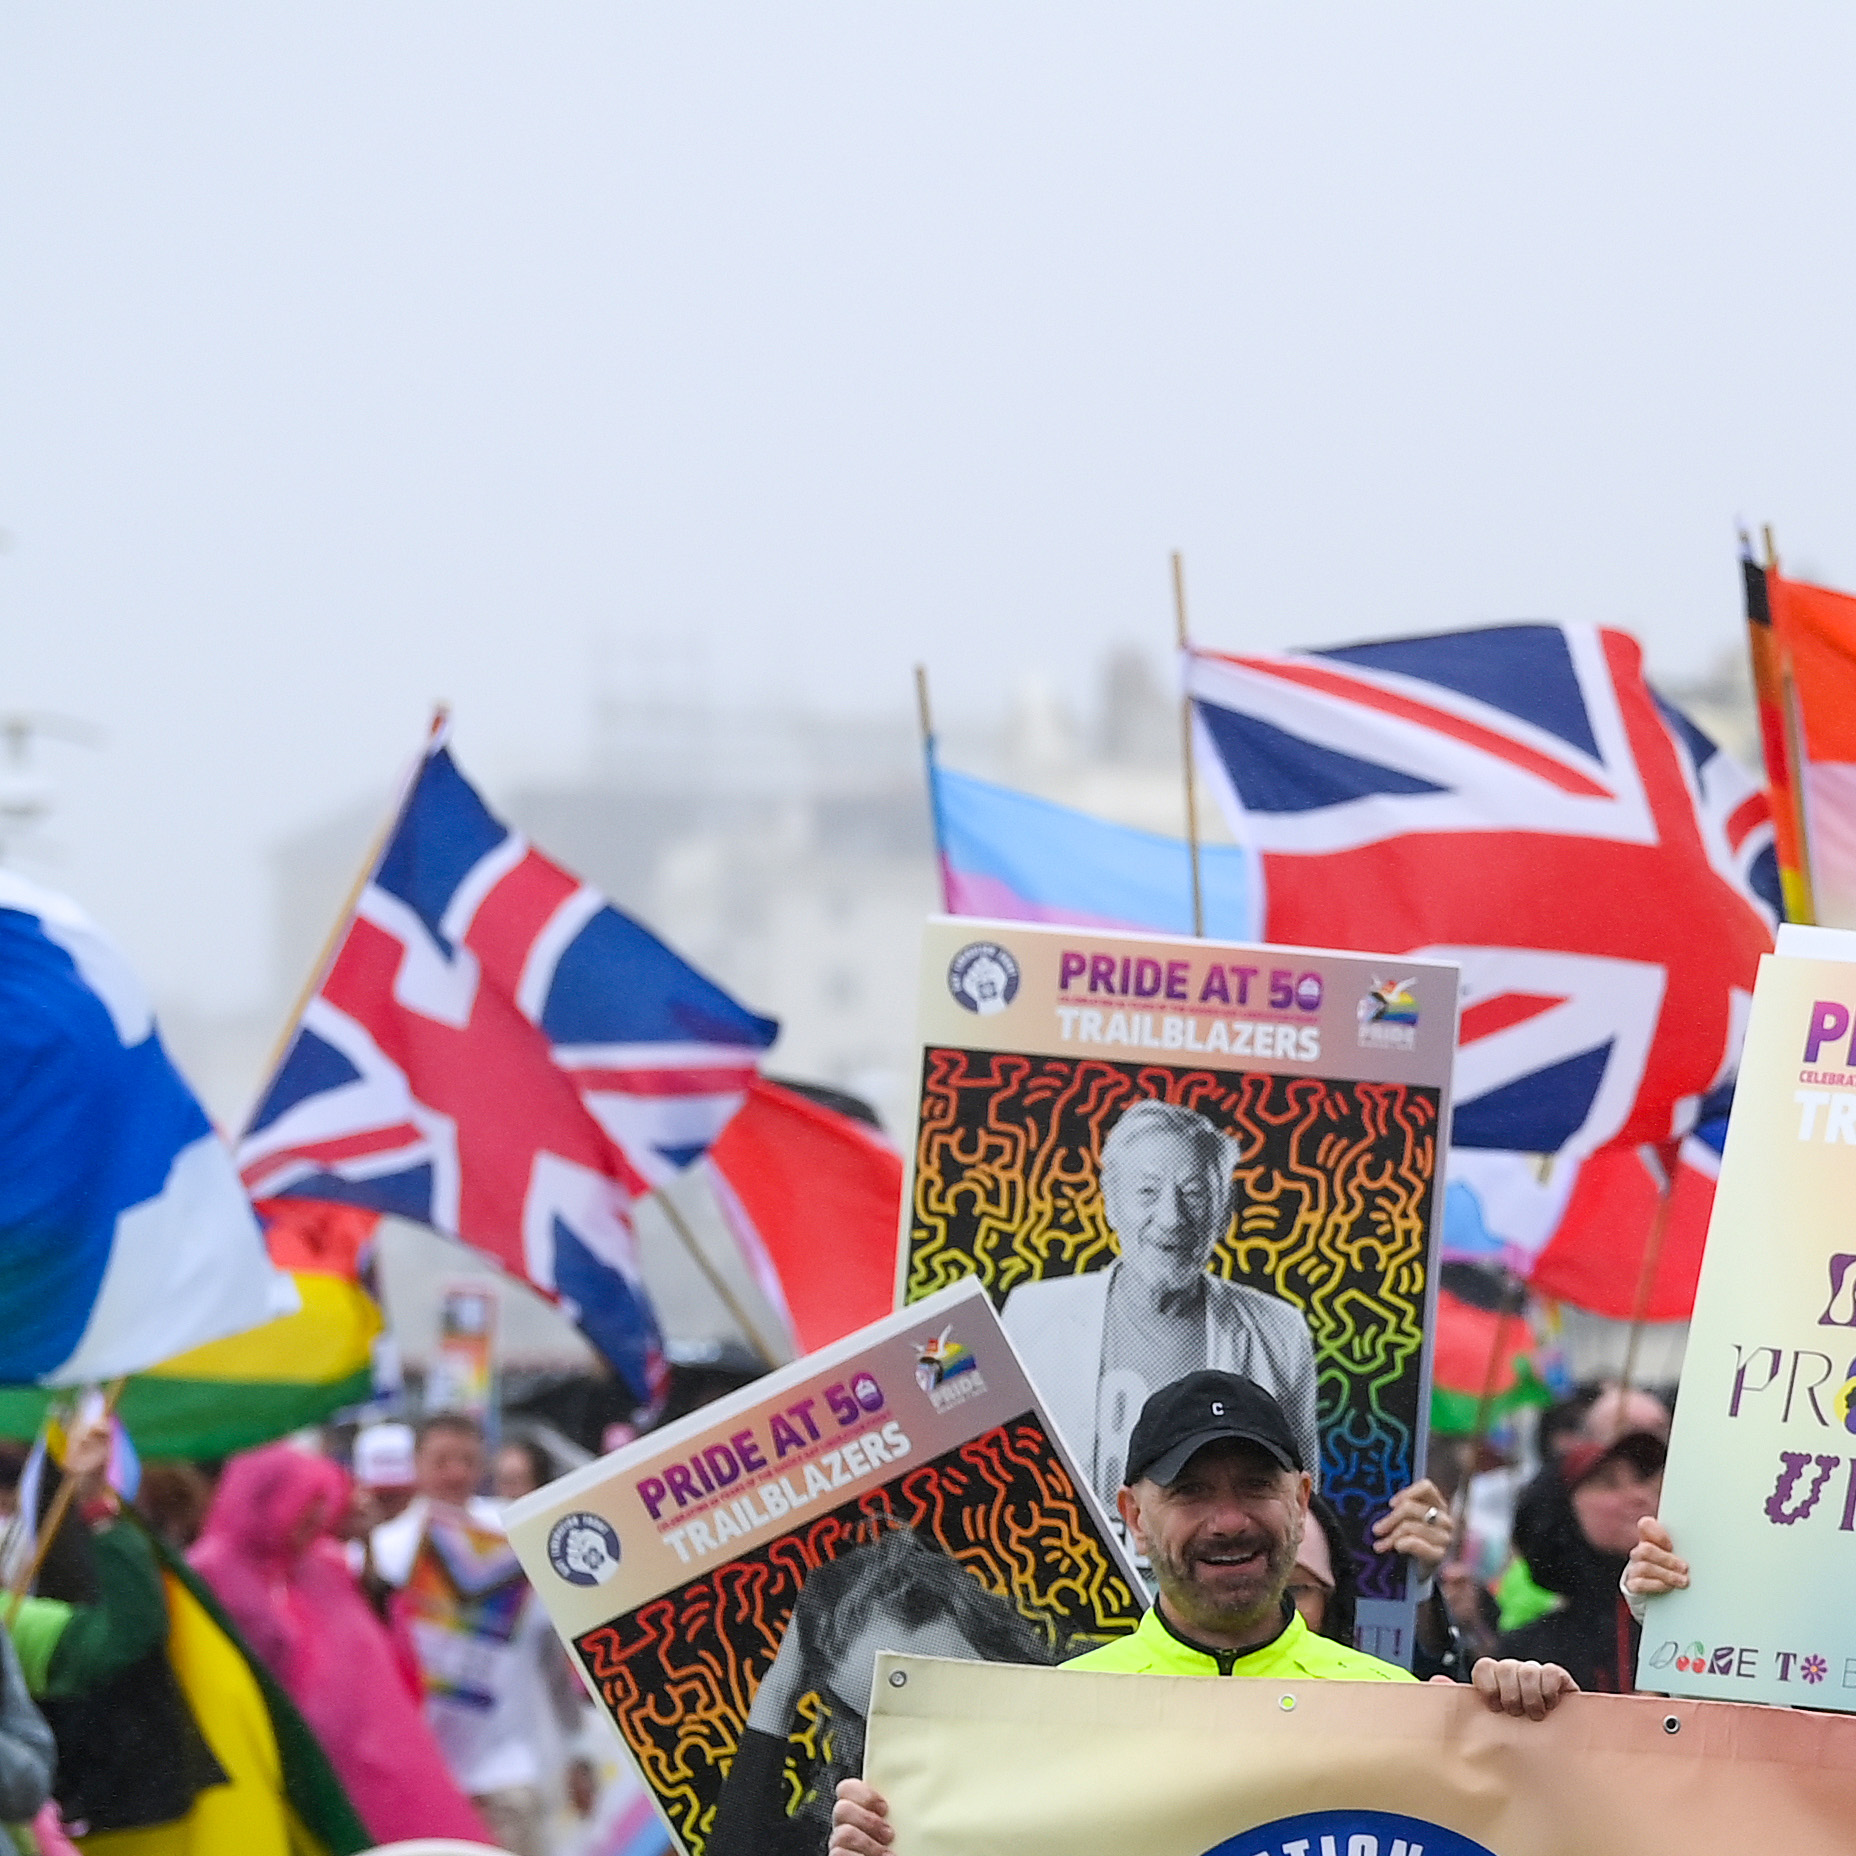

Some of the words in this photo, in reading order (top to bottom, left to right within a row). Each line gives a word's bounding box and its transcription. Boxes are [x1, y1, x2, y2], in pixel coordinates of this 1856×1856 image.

[1059, 951, 1190, 1001] PRIDE
[1200, 962, 1258, 1008] AT
[1269, 970, 1325, 1013] 50
[1055, 1006, 1322, 1062] TRAILBLAZERS
[1211, 1402, 1224, 1415] C
[635, 1430, 767, 1521] PRIDE
[769, 1400, 822, 1466] AT
[829, 1371, 885, 1427] 50
[662, 1423, 912, 1563] TRAILBLAZERS
